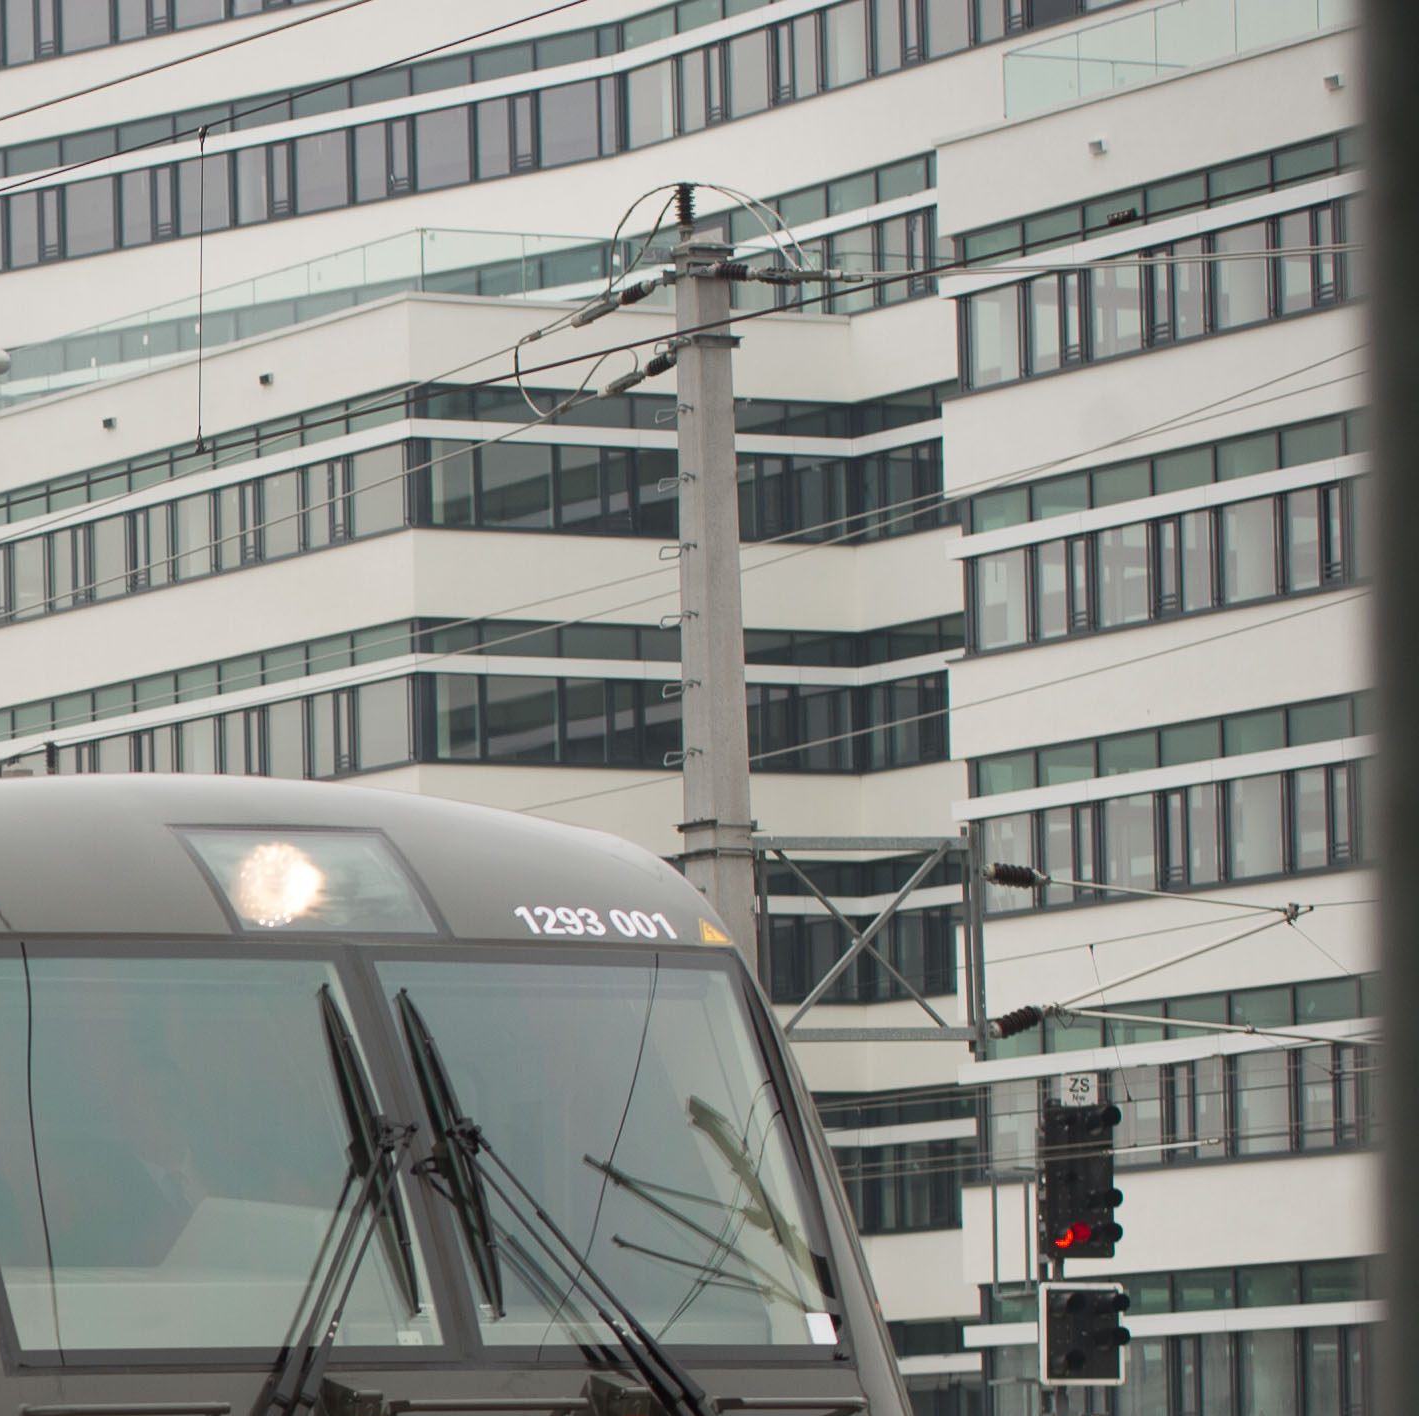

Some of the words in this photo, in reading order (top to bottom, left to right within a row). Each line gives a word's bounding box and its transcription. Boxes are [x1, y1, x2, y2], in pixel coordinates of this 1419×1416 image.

[514, 906, 606, 936] 1293
[609, 909, 677, 939] 001
[1069, 1077, 1090, 1093] ZS
